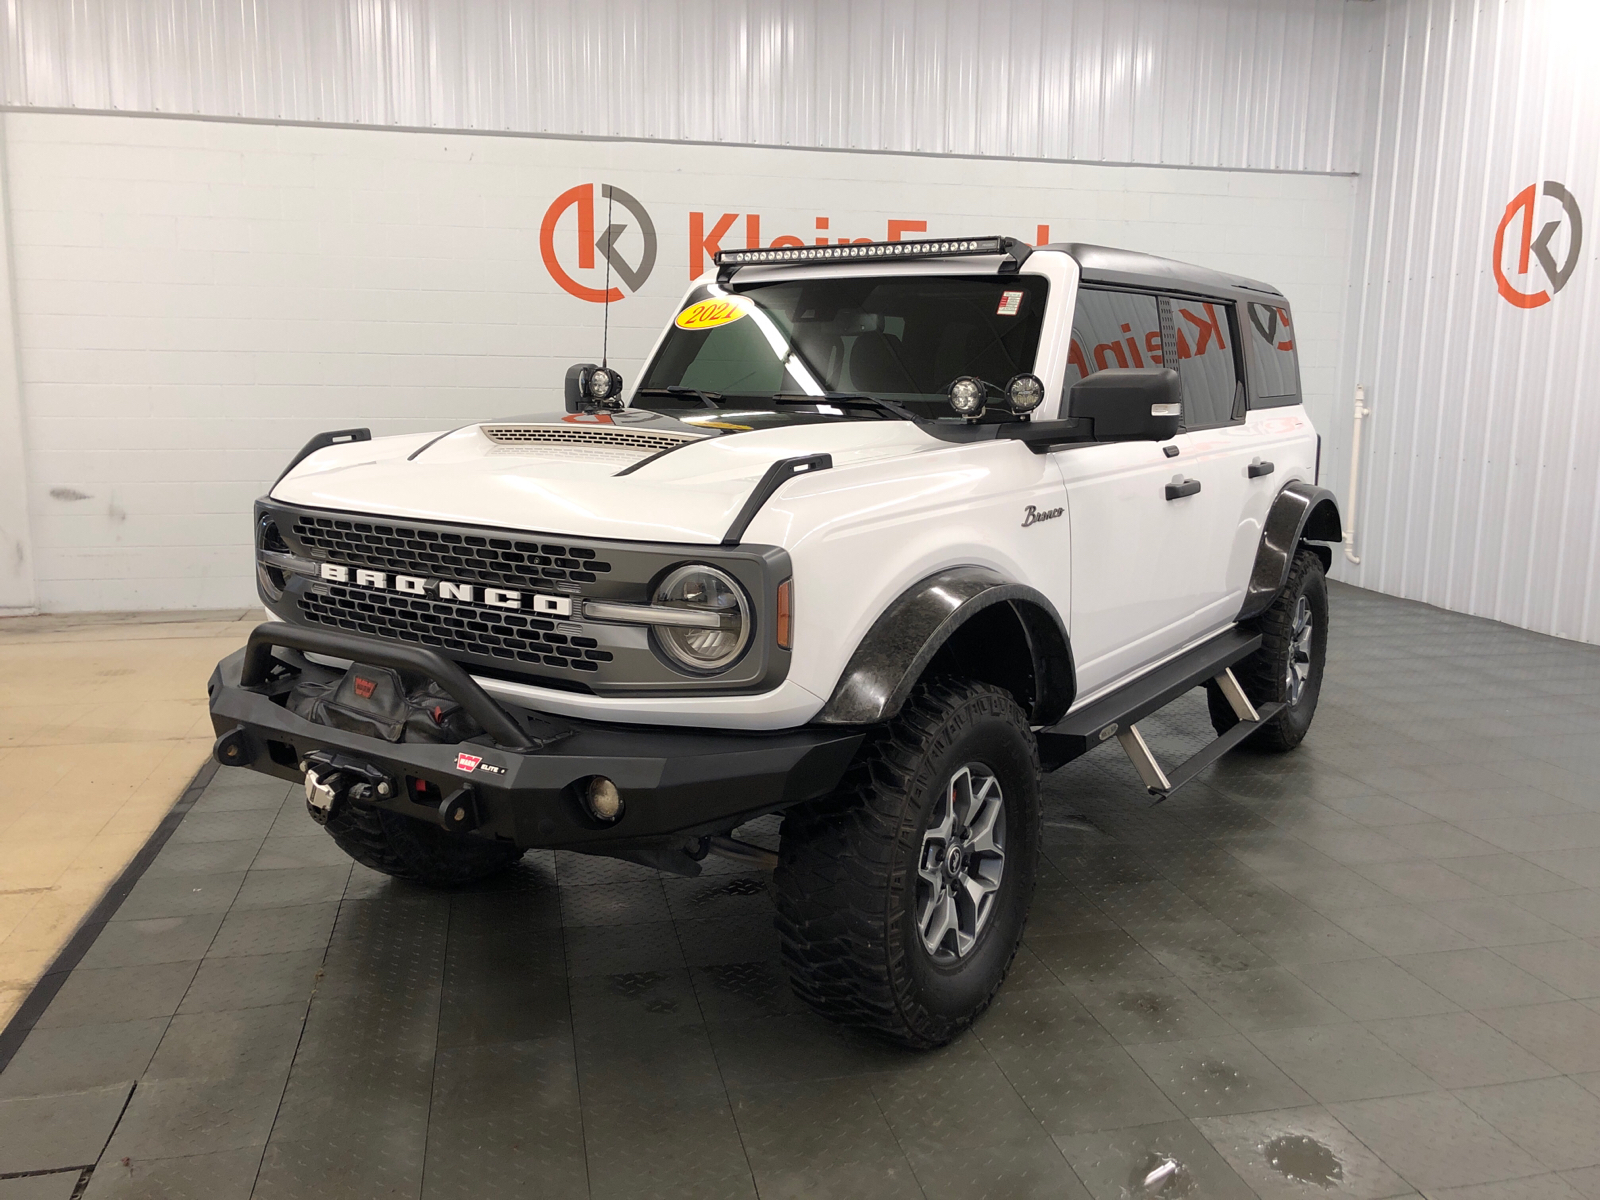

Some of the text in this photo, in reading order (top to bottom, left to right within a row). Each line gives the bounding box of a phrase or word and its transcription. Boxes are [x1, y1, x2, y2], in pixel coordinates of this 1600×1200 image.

[684, 302, 739, 324] 2021
[1021, 505, 1065, 527] Bronco
[321, 563, 572, 616] BRONCO
